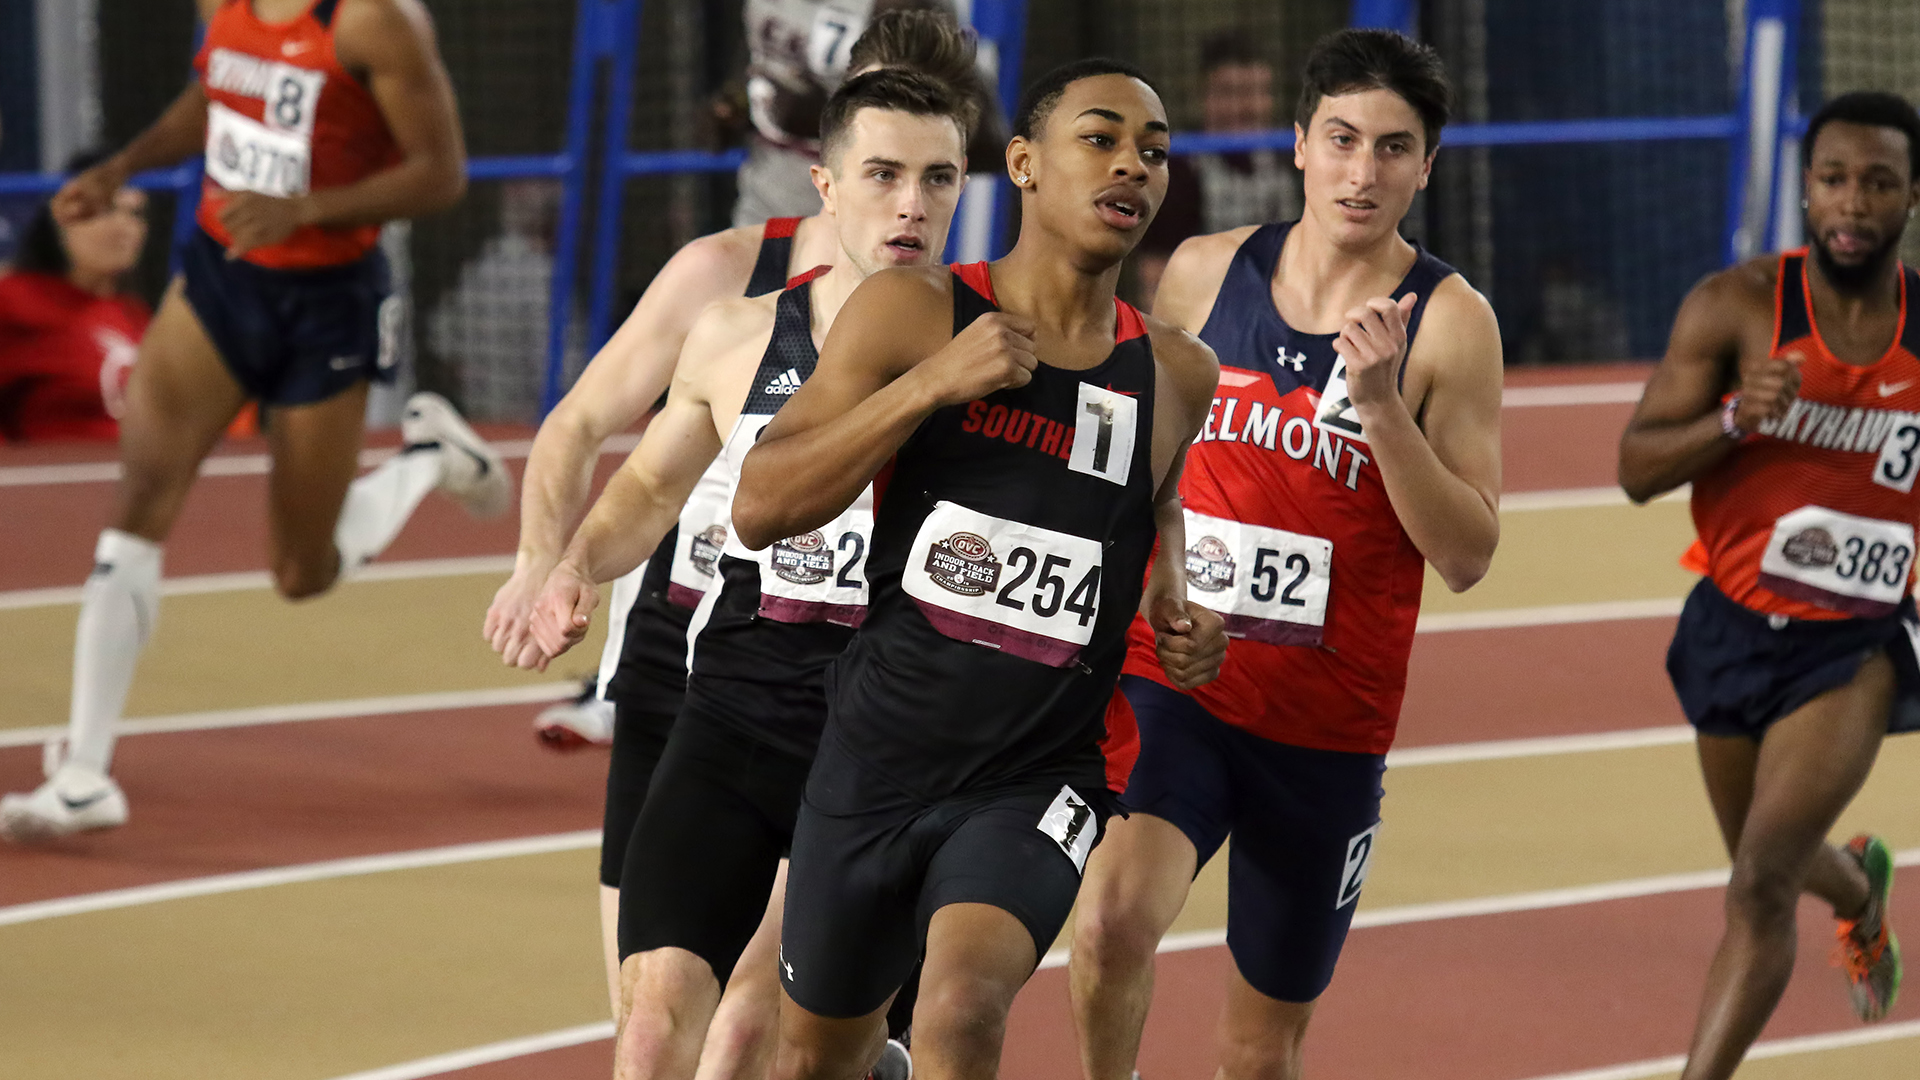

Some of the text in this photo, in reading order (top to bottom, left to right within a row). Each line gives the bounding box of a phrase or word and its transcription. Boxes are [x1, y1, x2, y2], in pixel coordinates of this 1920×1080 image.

[825, 20, 848, 65] 7
[274, 76, 304, 128] 8
[1085, 401, 1115, 474] 1
[1192, 397, 1370, 492] ELMONT
[776, 550, 830, 563] INDOOR TRACK
[776, 557, 830, 570] AND FIELD
[794, 535, 816, 546] OVC
[934, 552, 995, 576] INDOOR TRACK
[957, 540, 981, 554] OVC
[1836, 536, 1910, 586] 383
[932, 559, 957, 572] AND
[960, 567, 993, 583] FIELD
[995, 546, 1102, 627] 254
[1250, 547, 1311, 607] 52
[1341, 833, 1373, 902] 2
